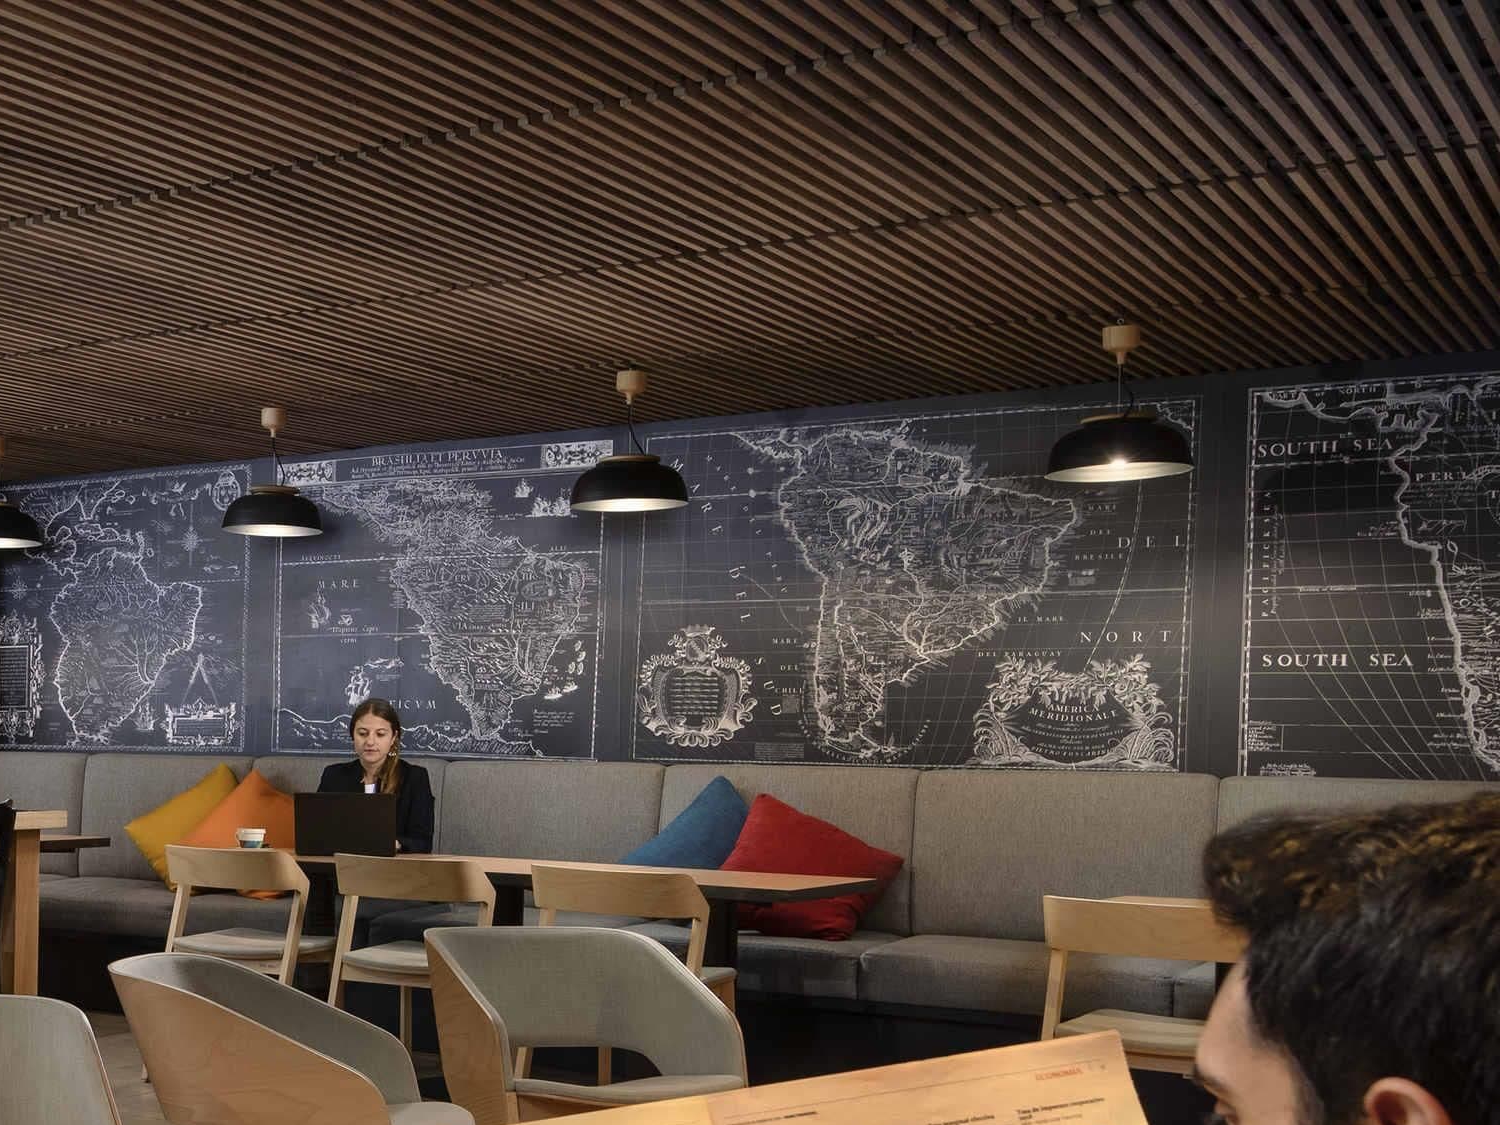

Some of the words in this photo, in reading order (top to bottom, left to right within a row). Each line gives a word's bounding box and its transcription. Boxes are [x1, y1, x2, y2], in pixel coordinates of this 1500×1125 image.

[1257, 440, 1339, 458] SOUTH
[1353, 437, 1393, 451] SEA
[1117, 535, 1186, 548] DEL
[318, 578, 360, 589] MARE
[1080, 630, 1172, 643] NORT
[1261, 653, 1349, 668] SOUTH
[1369, 653, 1414, 667] SEA
[1028, 707, 1119, 722] MERIDIONALE
[1045, 703, 1101, 713] AMERICA
